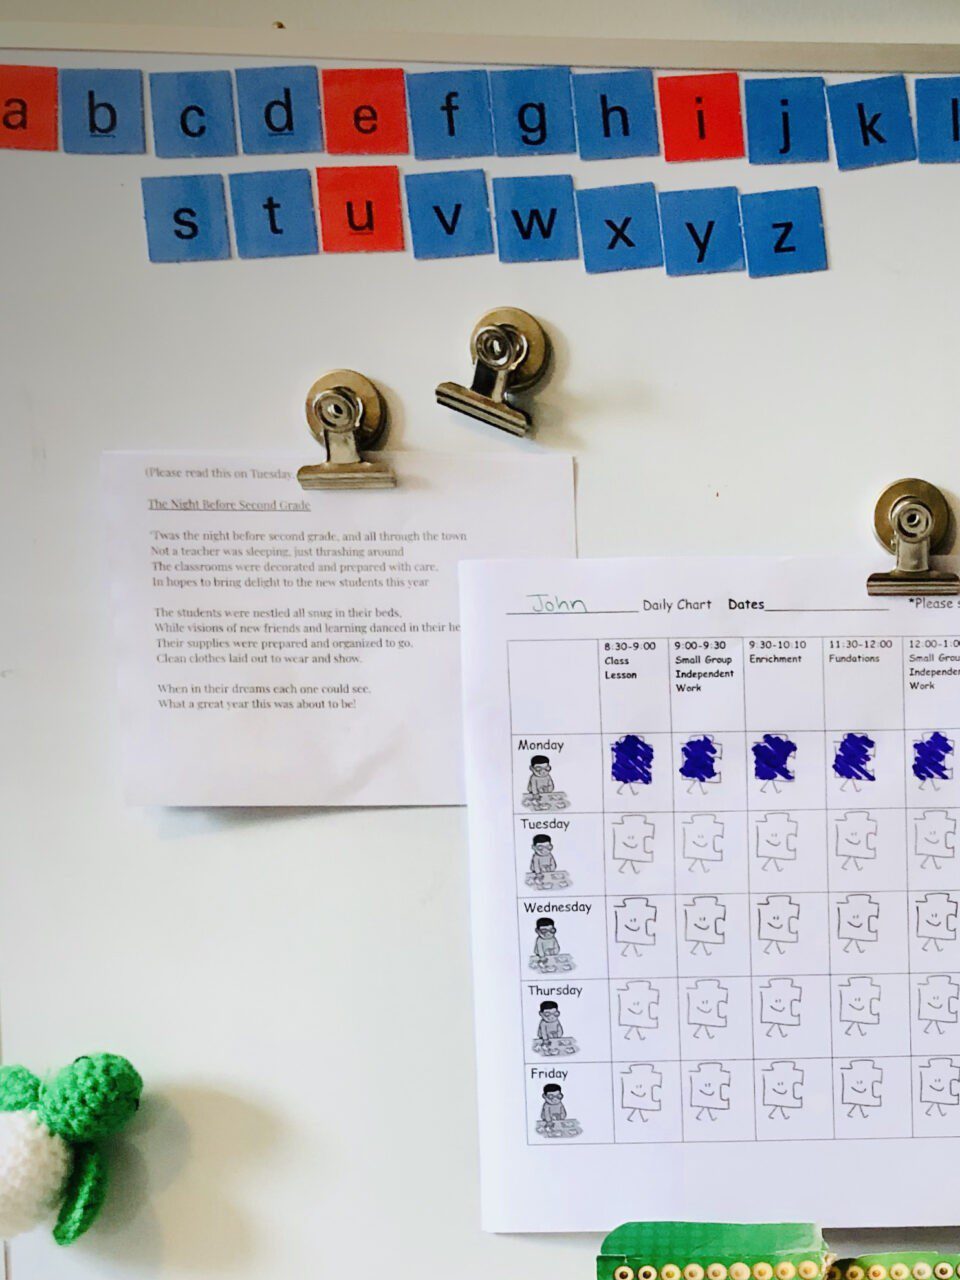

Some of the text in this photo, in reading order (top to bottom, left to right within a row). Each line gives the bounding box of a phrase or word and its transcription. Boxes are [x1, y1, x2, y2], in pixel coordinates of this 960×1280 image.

[3, 100, 28, 129] a
[88, 91, 116, 134] b
[180, 104, 206, 138] c
[265, 88, 293, 132] d
[353, 106, 378, 134] e
[440, 92, 459, 136] f
[518, 103, 547, 145] g
[601, 95, 630, 137] h
[696, 96, 706, 139] i
[778, 99, 791, 154] j
[858, 103, 885, 146] k
[951, 99, 960, 142] l
[173, 197, 796, 263] s t u v w x y z
[149, 498, 311, 512] The Night Before Second Grade
[526, 593, 588, 613] John
[643, 599, 765, 614] Daily Chart Dates
[604, 641, 656, 651] 8:30-9:00
[675, 640, 726, 651] 9:00-9:30
[749, 640, 806, 650] 9:30-10:10
[829, 639, 893, 649] 11:30-12:00
[157, 654, 186, 664] Clean
[189, 654, 225, 664] clothes
[229, 653, 248, 664] laid
[251, 654, 267, 664] out
[270, 655, 281, 664] to
[284, 655, 308, 664] wear
[312, 654, 330, 664] and
[605, 656, 629, 666] Class
[675, 655, 732, 667] Small Group
[750, 654, 801, 664] Enrichment
[829, 653, 880, 664] Fundations
[909, 653, 935, 663] Small
[605, 670, 637, 680] Lesson
[675, 669, 734, 680] Independent
[676, 683, 701, 693] Work
[910, 680, 935, 691] Work
[518, 739, 564, 753] Monday
[519, 818, 570, 832] Tuesday
[523, 901, 592, 916] Wednesday
[528, 984, 583, 998] Thursday
[530, 1068, 568, 1081] Friday
